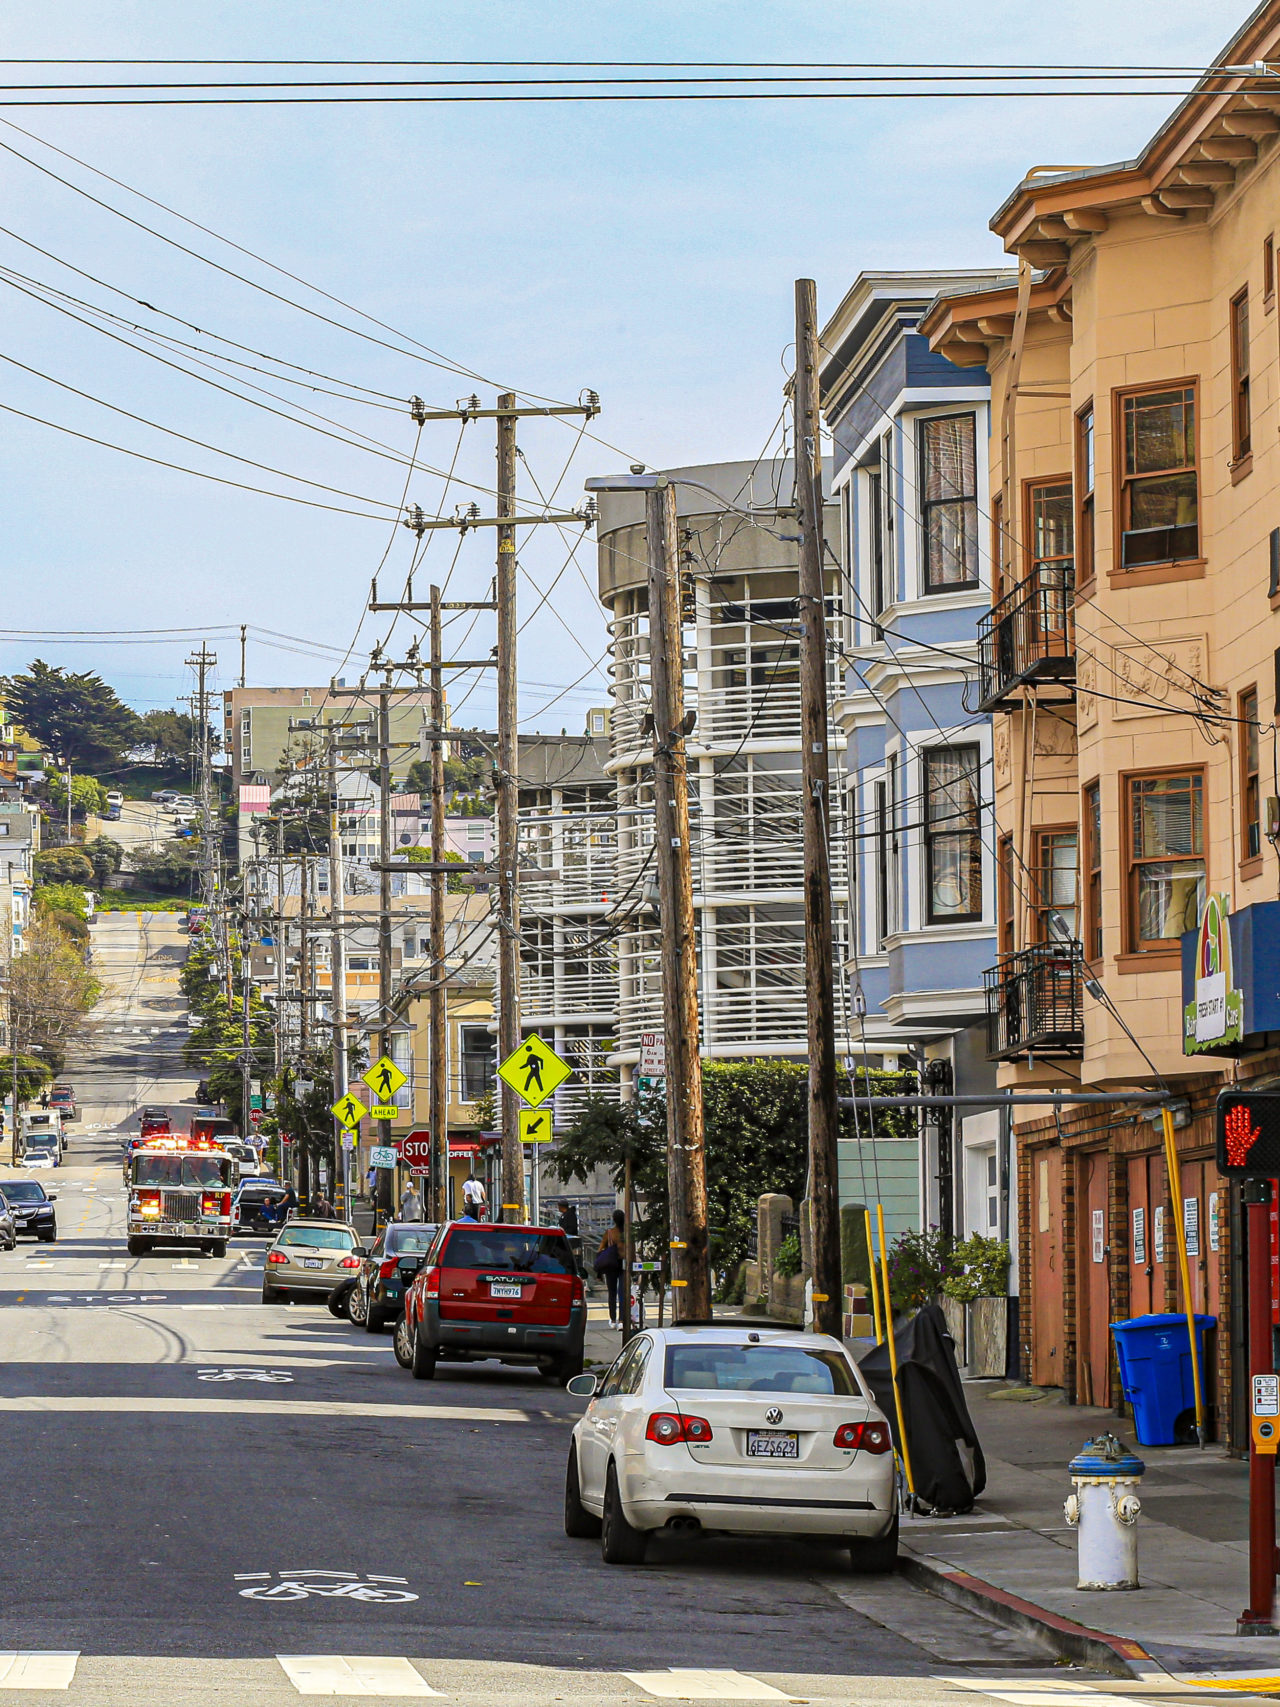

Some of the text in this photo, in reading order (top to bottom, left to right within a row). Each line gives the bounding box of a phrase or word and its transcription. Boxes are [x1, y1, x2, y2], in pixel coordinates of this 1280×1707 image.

[643, 1035, 654, 1046] NO
[405, 1142, 429, 1156] STO
[750, 1440, 795, 1452] 6EZS629
